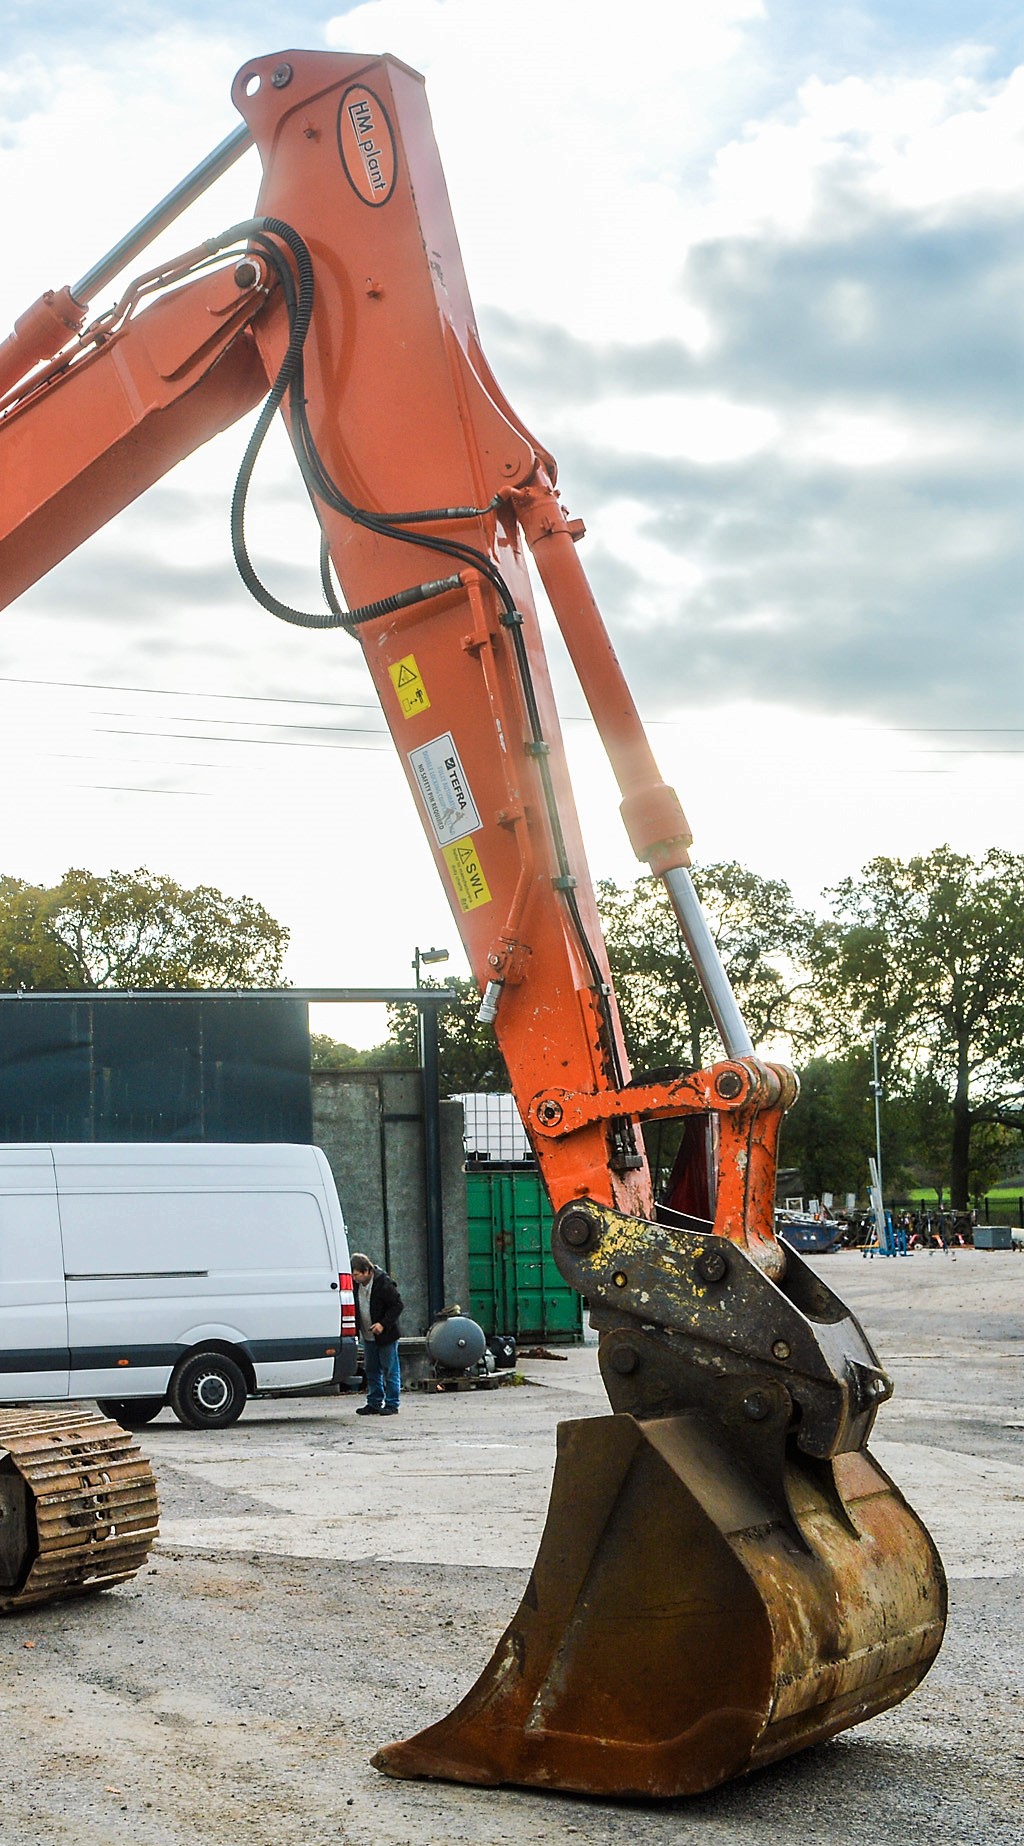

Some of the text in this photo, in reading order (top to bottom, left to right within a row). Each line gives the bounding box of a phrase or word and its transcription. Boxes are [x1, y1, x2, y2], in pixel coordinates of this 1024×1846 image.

[355, 101, 386, 189] HM plant
[418, 763, 424, 773] NO
[420, 773, 431, 791] SAFETY
[449, 770, 467, 810] TEFRA
[427, 791, 435, 802] PIN
[466, 863, 484, 899] SWL
